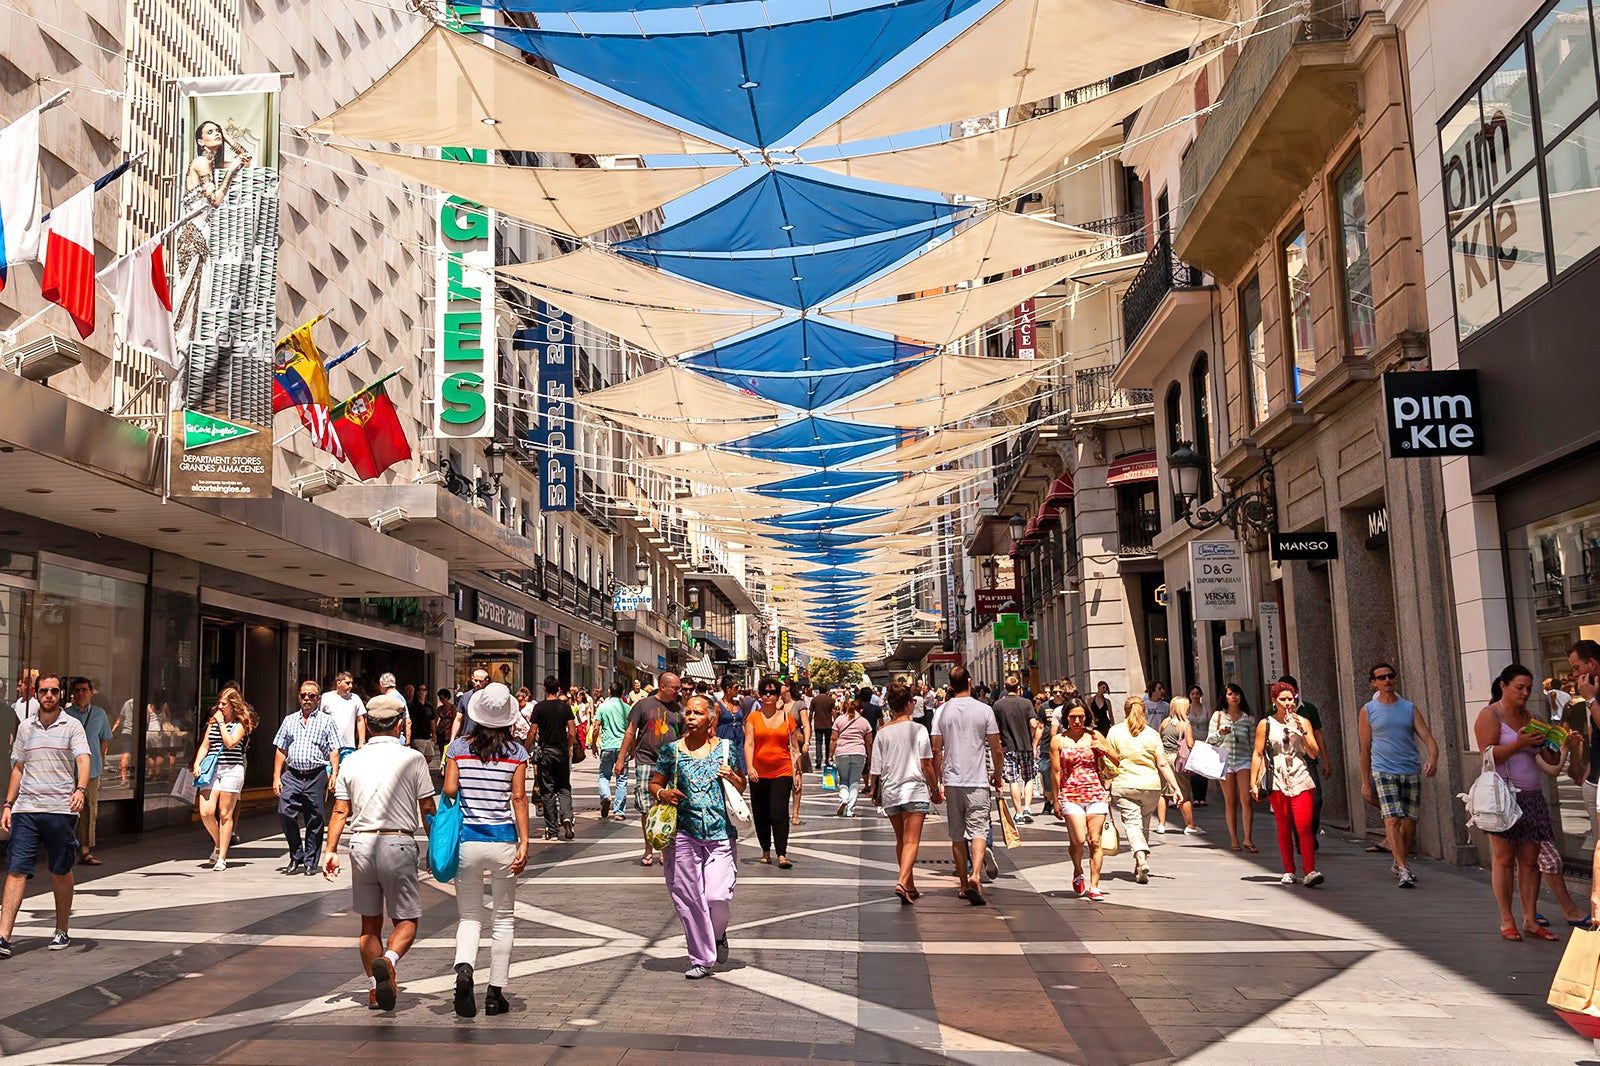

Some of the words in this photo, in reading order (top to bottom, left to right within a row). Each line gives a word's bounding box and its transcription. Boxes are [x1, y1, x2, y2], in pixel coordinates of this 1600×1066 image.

[547, 380, 567, 506] SPORT
[183, 455, 230, 464] DEPARTMENT
[232, 457, 262, 465] STORES
[180, 462, 216, 472] GRANDES
[217, 464, 265, 474] ALMACENES
[191, 484, 251, 494] elcorteingles.es
[1280, 541, 1328, 551] MANGO
[1203, 564, 1233, 575] D&G
[1204, 592, 1236, 600] VERSACE
[478, 597, 504, 625] SPORT
[507, 609, 525, 632] 2000
